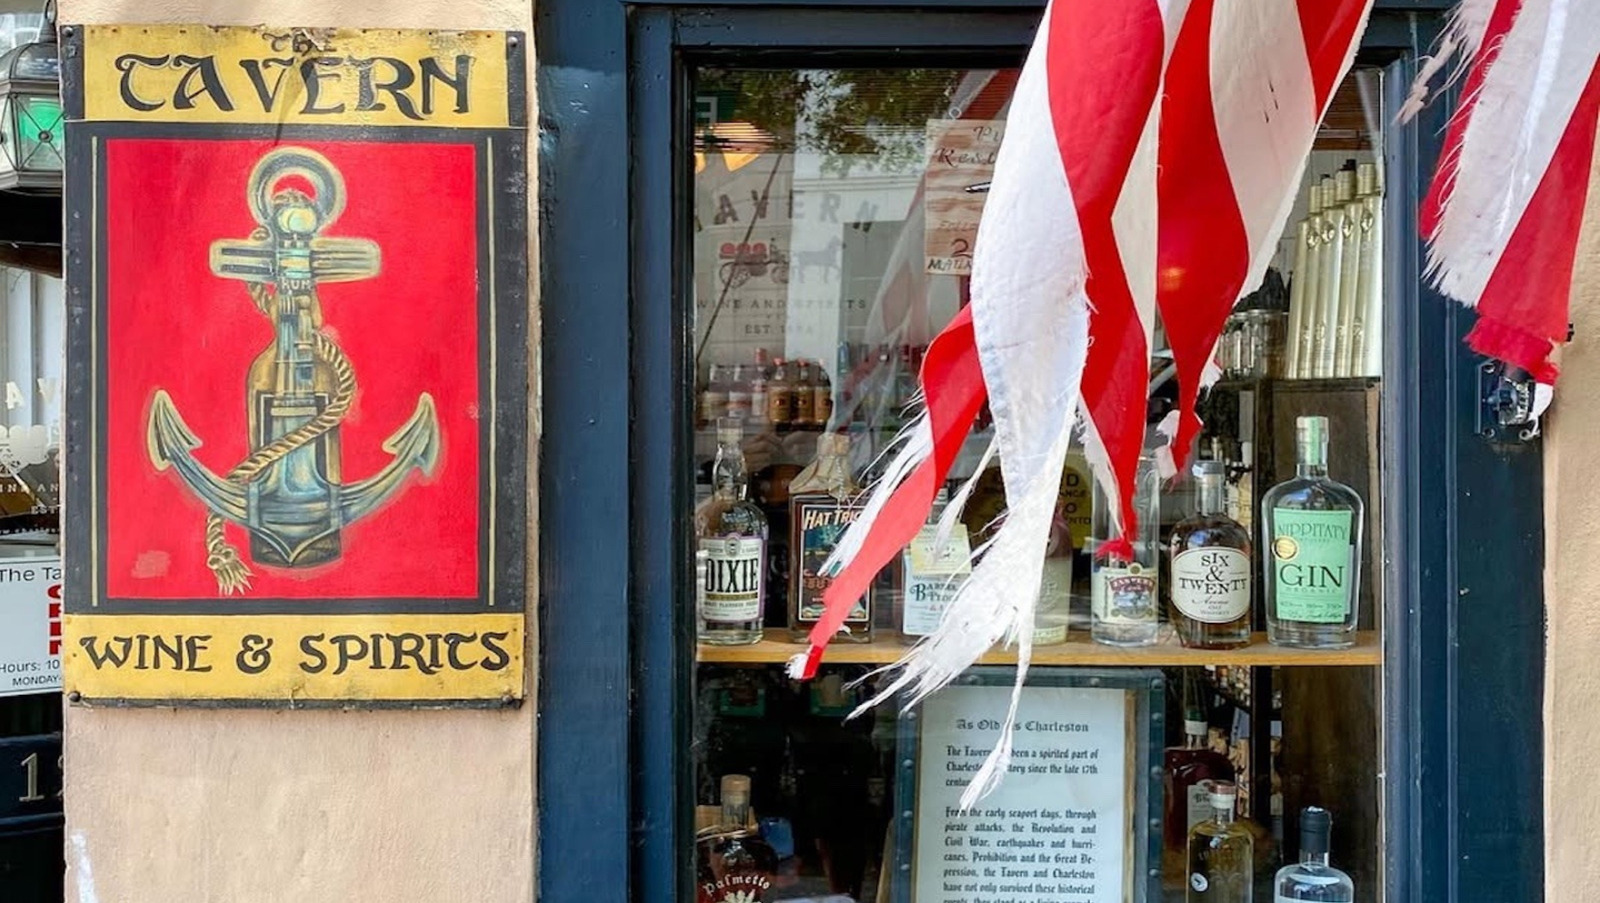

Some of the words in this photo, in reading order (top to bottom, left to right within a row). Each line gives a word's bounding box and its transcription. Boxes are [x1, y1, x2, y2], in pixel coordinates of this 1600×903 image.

[115, 54, 476, 120] TAVERN
[282, 278, 311, 290] RUM
[803, 510, 833, 530] HAT
[834, 509, 860, 525] TRIC
[1201, 553, 1229, 566] SIX
[705, 558, 758, 592] DIXIE
[1206, 565, 1225, 582] &
[1281, 564, 1344, 587] GIN
[1179, 577, 1247, 594] TWENTY
[79, 634, 212, 672] WINE
[235, 634, 273, 674] &
[300, 632, 509, 675] SPIRITS
[957, 719, 973, 730] As
[977, 719, 1000, 731] Old
[1025, 721, 1089, 732] Charleston
[947, 745, 961, 756] The
[1039, 749, 1069, 760] spirited
[1071, 750, 1088, 760] part
[1090, 749, 1099, 758] of
[1028, 763, 1047, 773] since
[1050, 764, 1062, 773] the
[1064, 764, 1079, 774] late
[970, 807, 982, 817] the
[985, 808, 1005, 819] early
[1008, 808, 1037, 819] seaport
[1065, 809, 1097, 821] through
[945, 823, 968, 833] pirate
[1012, 823, 1024, 833] the
[1031, 822, 1074, 834] Revolution
[1081, 824, 1096, 834] and
[945, 836, 963, 847] Civil
[996, 838, 1045, 849] earthquakes
[1051, 839, 1066, 849] and
[972, 851, 1018, 863] Prohibition
[1020, 853, 1036, 863] and
[1039, 853, 1051, 863] the
[1054, 853, 1077, 864] Great
[984, 867, 996, 877] the
[1001, 867, 1028, 878] Tavern
[1033, 868, 1048, 878] and
[1053, 868, 1095, 879] Charleston
[943, 882, 961, 891] have
[964, 883, 978, 892] not
[980, 882, 997, 894] only
[999, 882, 1033, 893] survived
[1035, 883, 1056, 893] these
[1057, 883, 1095, 894] historical
